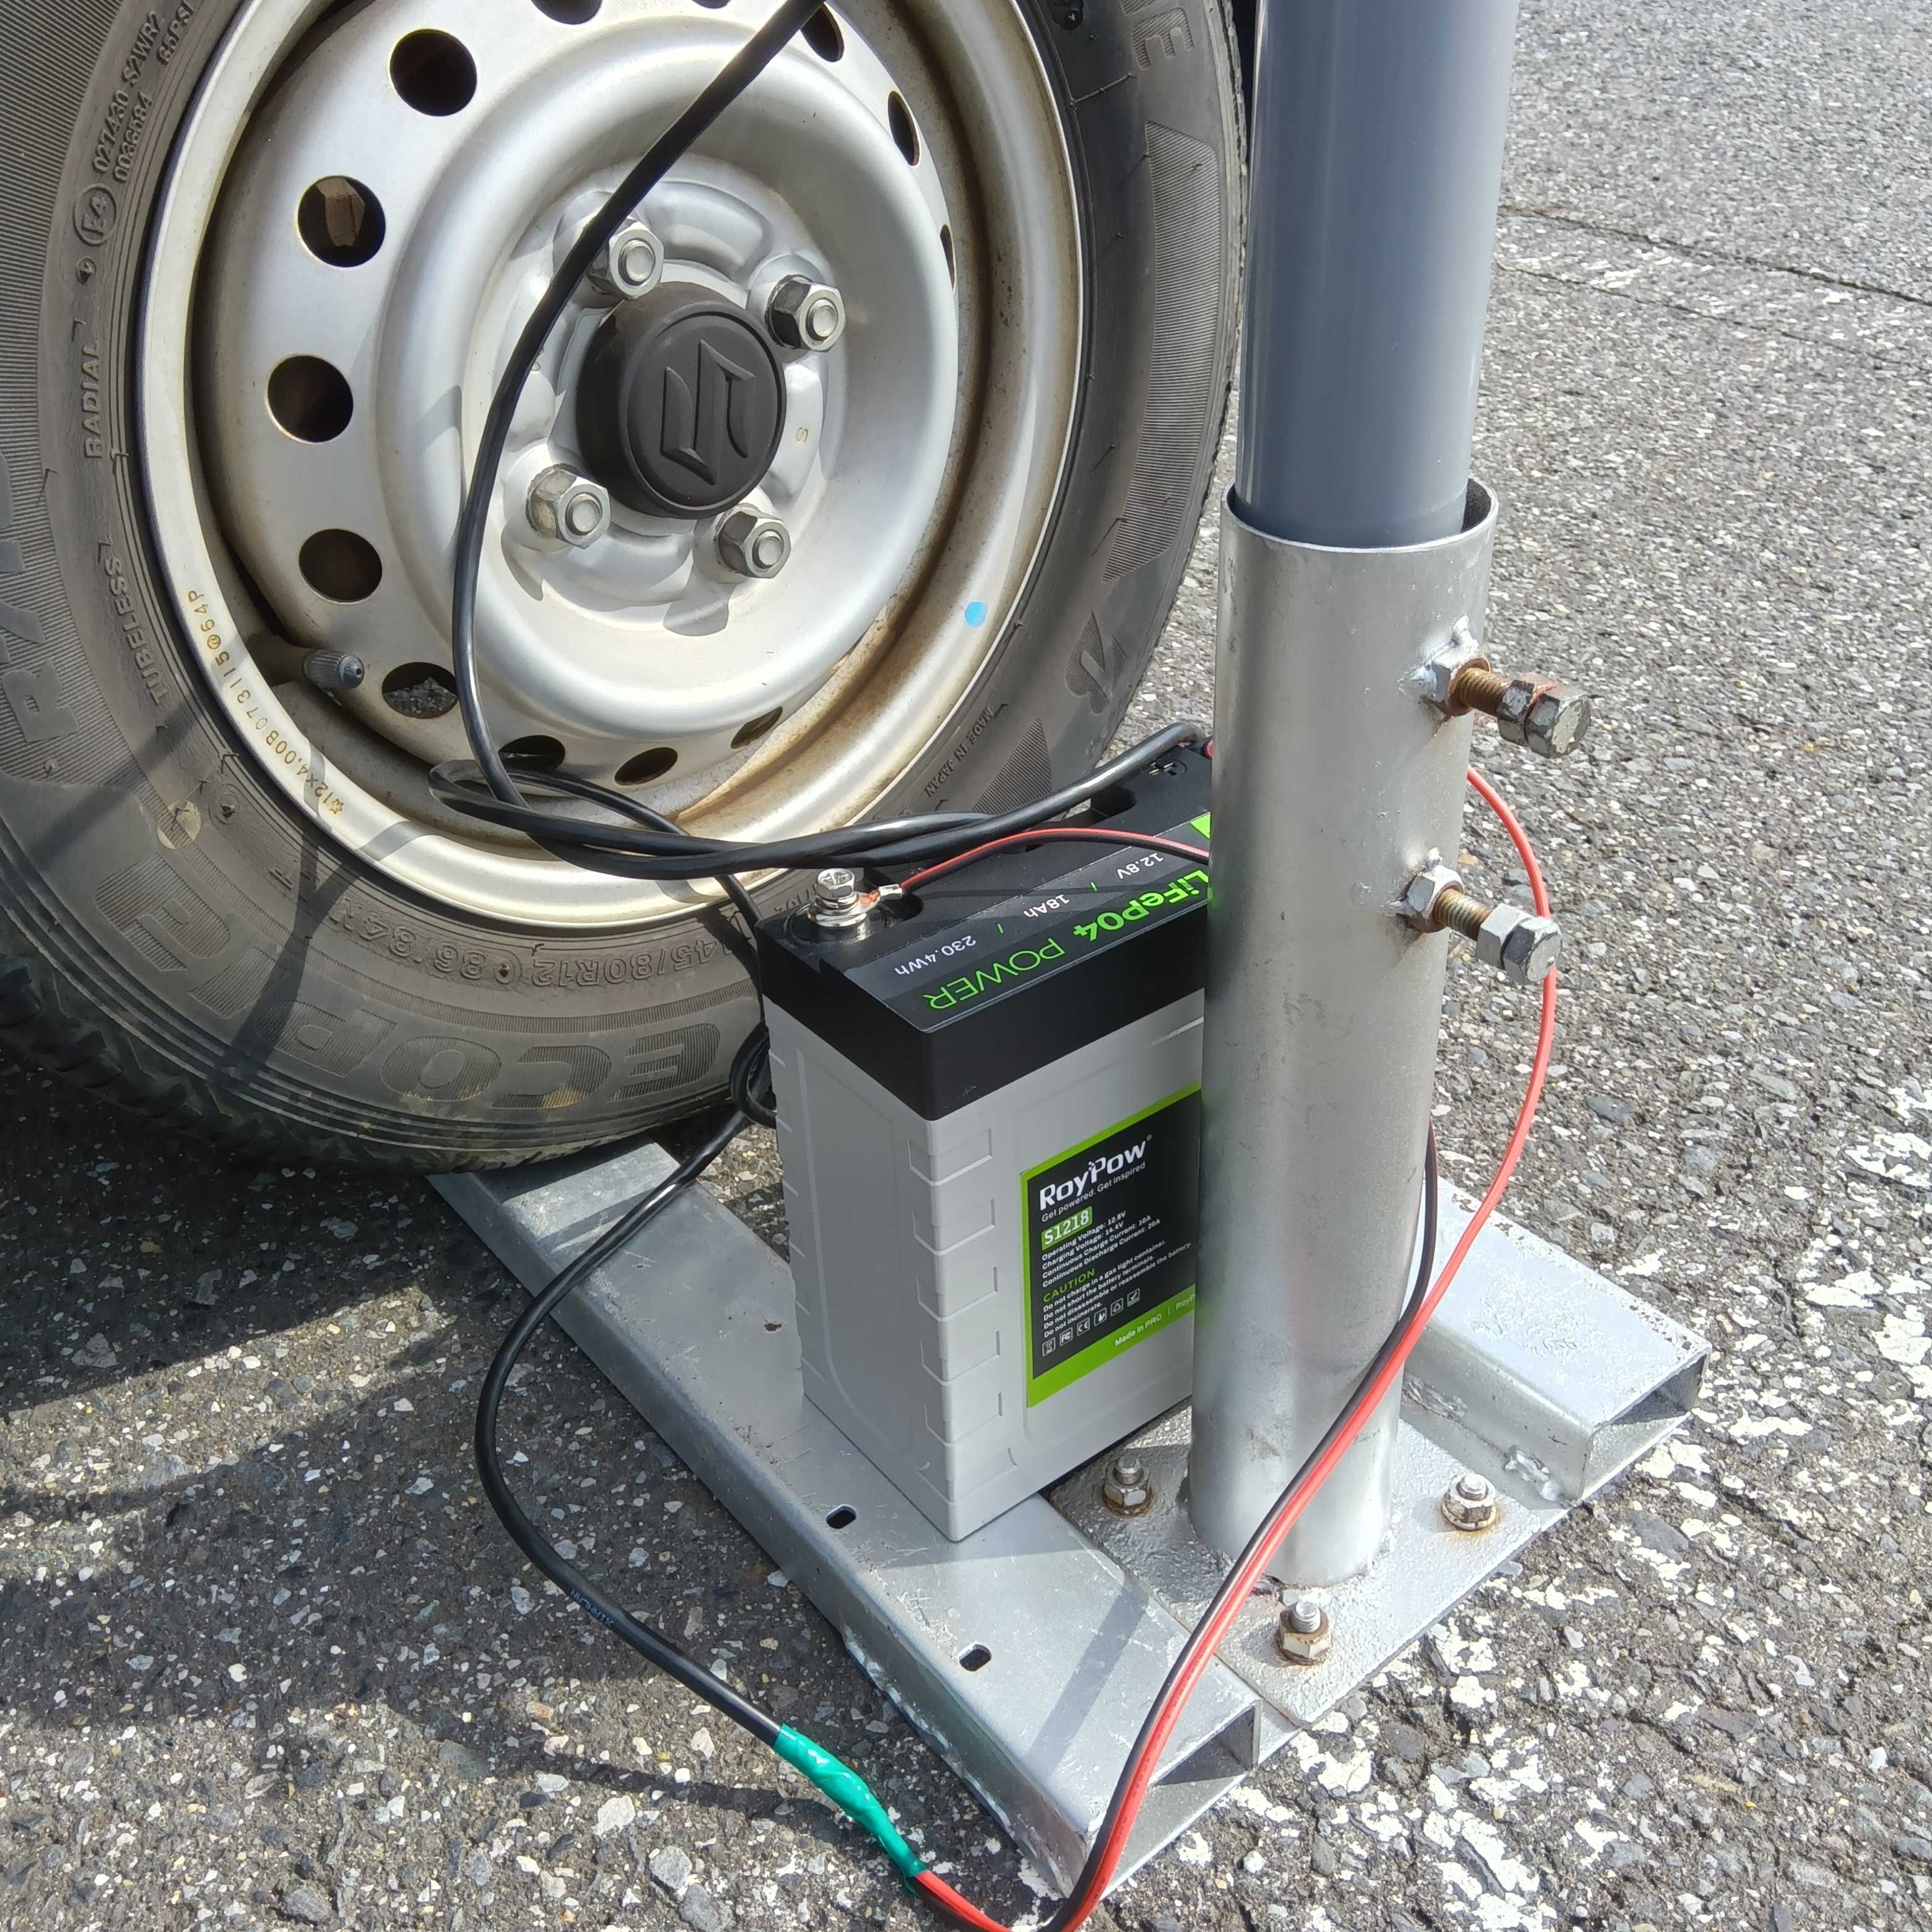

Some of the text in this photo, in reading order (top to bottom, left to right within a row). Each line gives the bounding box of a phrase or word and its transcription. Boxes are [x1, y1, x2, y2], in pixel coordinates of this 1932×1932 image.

[81, 339, 103, 459] RADIAL
[104, 557, 169, 705] TUBELESS
[924, 707, 994, 797] MADE IN JAPAN
[894, 852, 1164, 976] 12.8V 18Ah 230.4Wh
[923, 938, 1066, 1009] POWER
[1042, 1161, 1145, 1222] Get powered. Get inspired
[1042, 1210, 1126, 1261] Operating Voltage: 12.8V
[1042, 1221, 1123, 1270] Charging Voltage: 14.4V
[1042, 1214, 1151, 1279] Continuous Charge Current: 10A
[1042, 1261, 1082, 1288] Continuous
[1084, 1242, 1118, 1265] Discharge
[1119, 1225, 1146, 1245] Current:
[1044, 1208, 1089, 1247] S1218
[1043, 1302, 1053, 1312] Do
[1055, 1295, 1065, 1306] not
[1067, 1282, 1090, 1299] charge
[1104, 1267, 1116, 1279] gas
[1118, 1256, 1133, 1270] tight
[1043, 1268, 1094, 1303] CAUTION
[1043, 1255, 1154, 1321] Do not short the battery terminals.
[1044, 1320, 1053, 1329] Do
[1055, 1312, 1066, 1323] not
[1067, 1287, 1109, 1316] disassemble
[1110, 1283, 1117, 1292] or
[1118, 1261, 1155, 1287] reassemble
[1157, 1255, 1167, 1264] the
[1045, 1302, 1102, 1338] Do not incinerate.
[1115, 1329, 1135, 1347] Made
[1137, 1324, 1143, 1334] in
